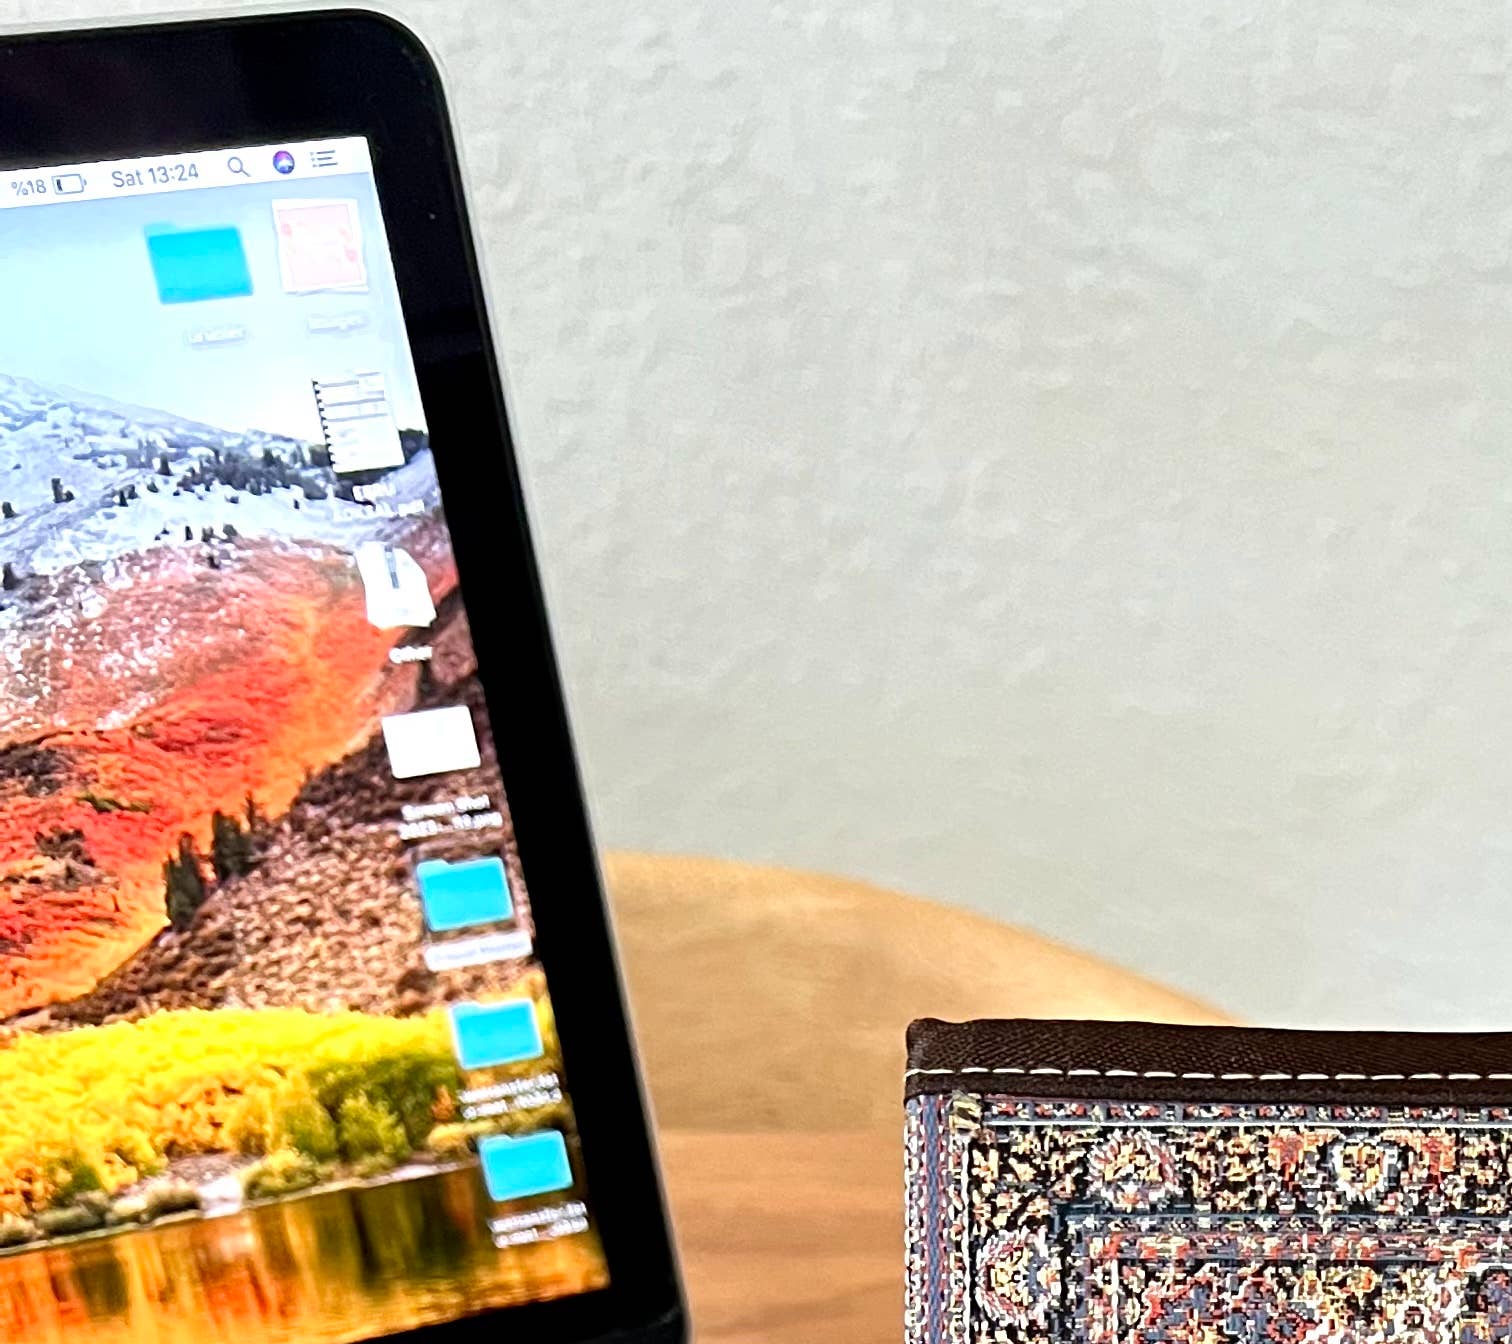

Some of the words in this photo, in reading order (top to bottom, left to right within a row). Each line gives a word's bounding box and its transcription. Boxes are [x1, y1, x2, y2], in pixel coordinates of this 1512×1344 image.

[111, 170, 144, 188] Sat
[147, 163, 200, 185] 13:24
[10, 178, 48, 197] %18
